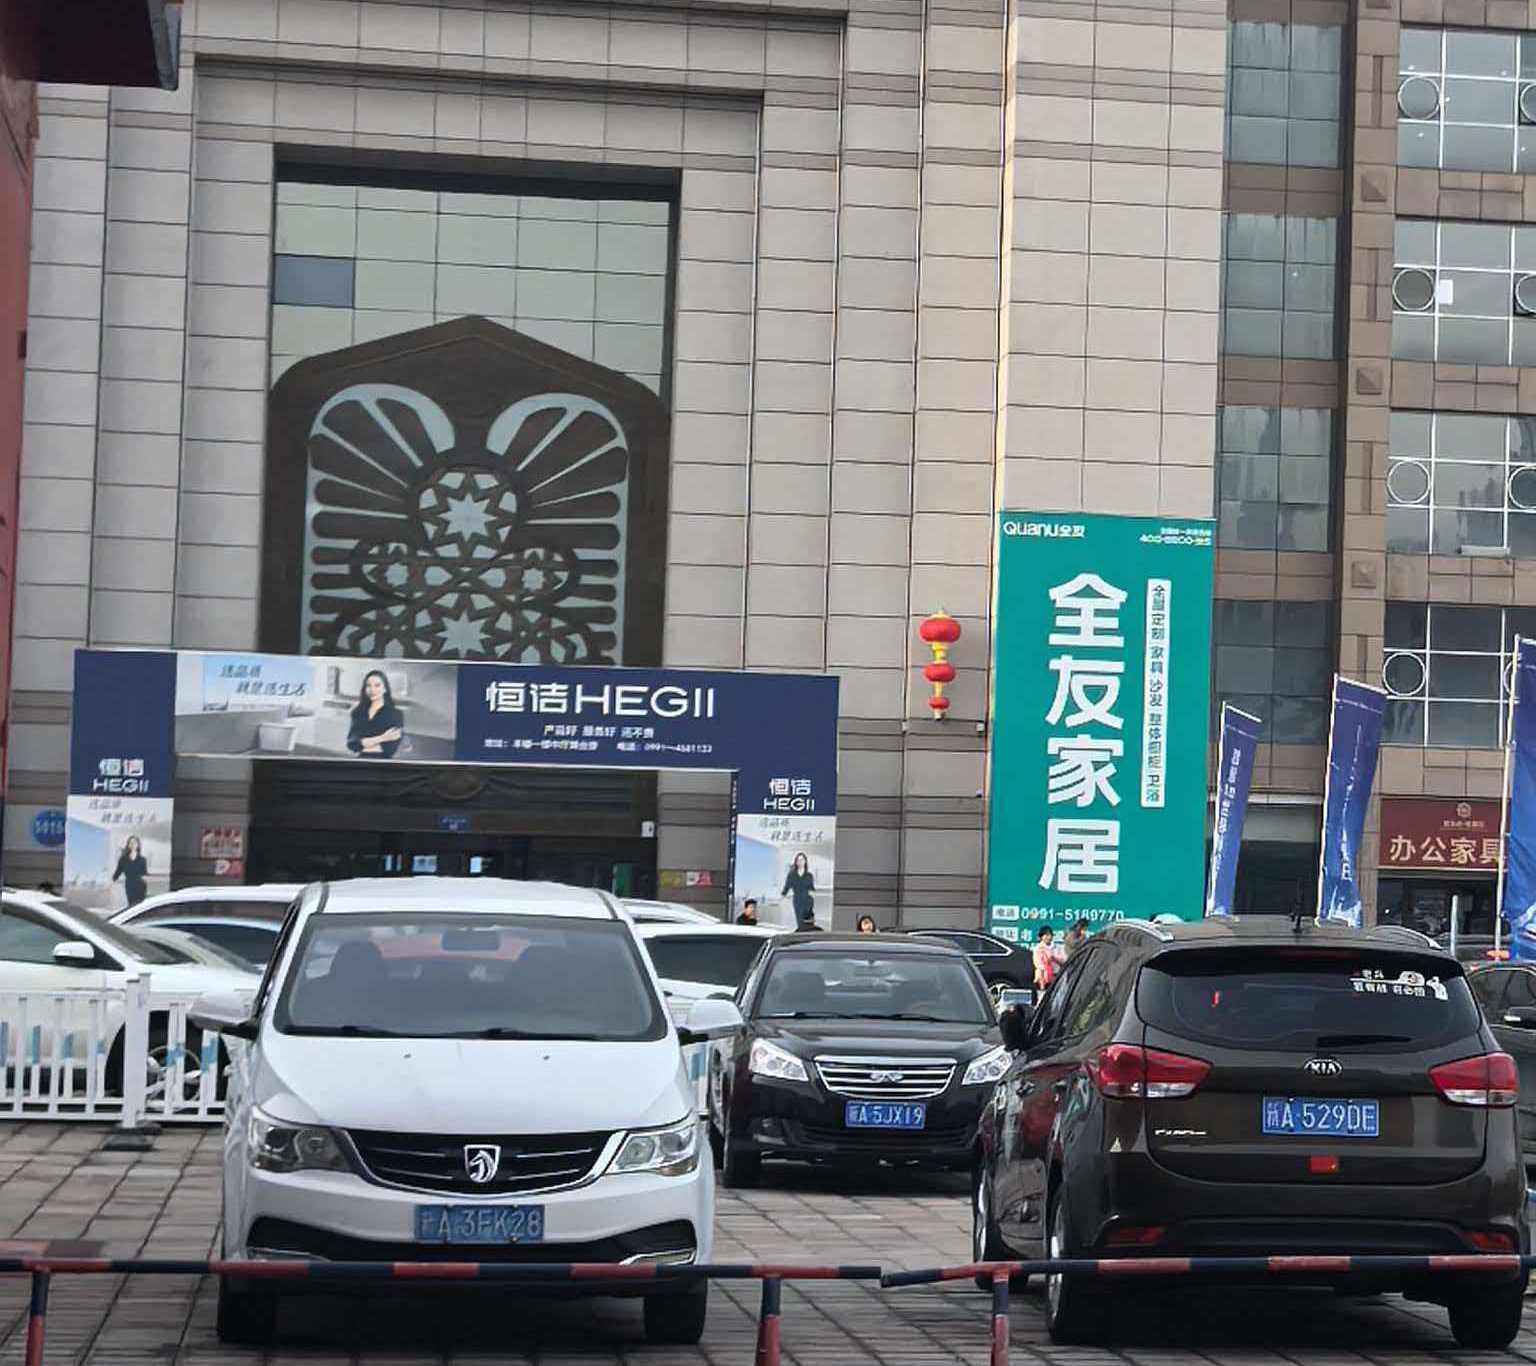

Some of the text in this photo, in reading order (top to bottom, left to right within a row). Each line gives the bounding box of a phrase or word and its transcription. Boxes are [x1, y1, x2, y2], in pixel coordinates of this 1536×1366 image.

[1038, 573, 1128, 893] 全友家居
[1310, 1060, 1336, 1075] KIA
